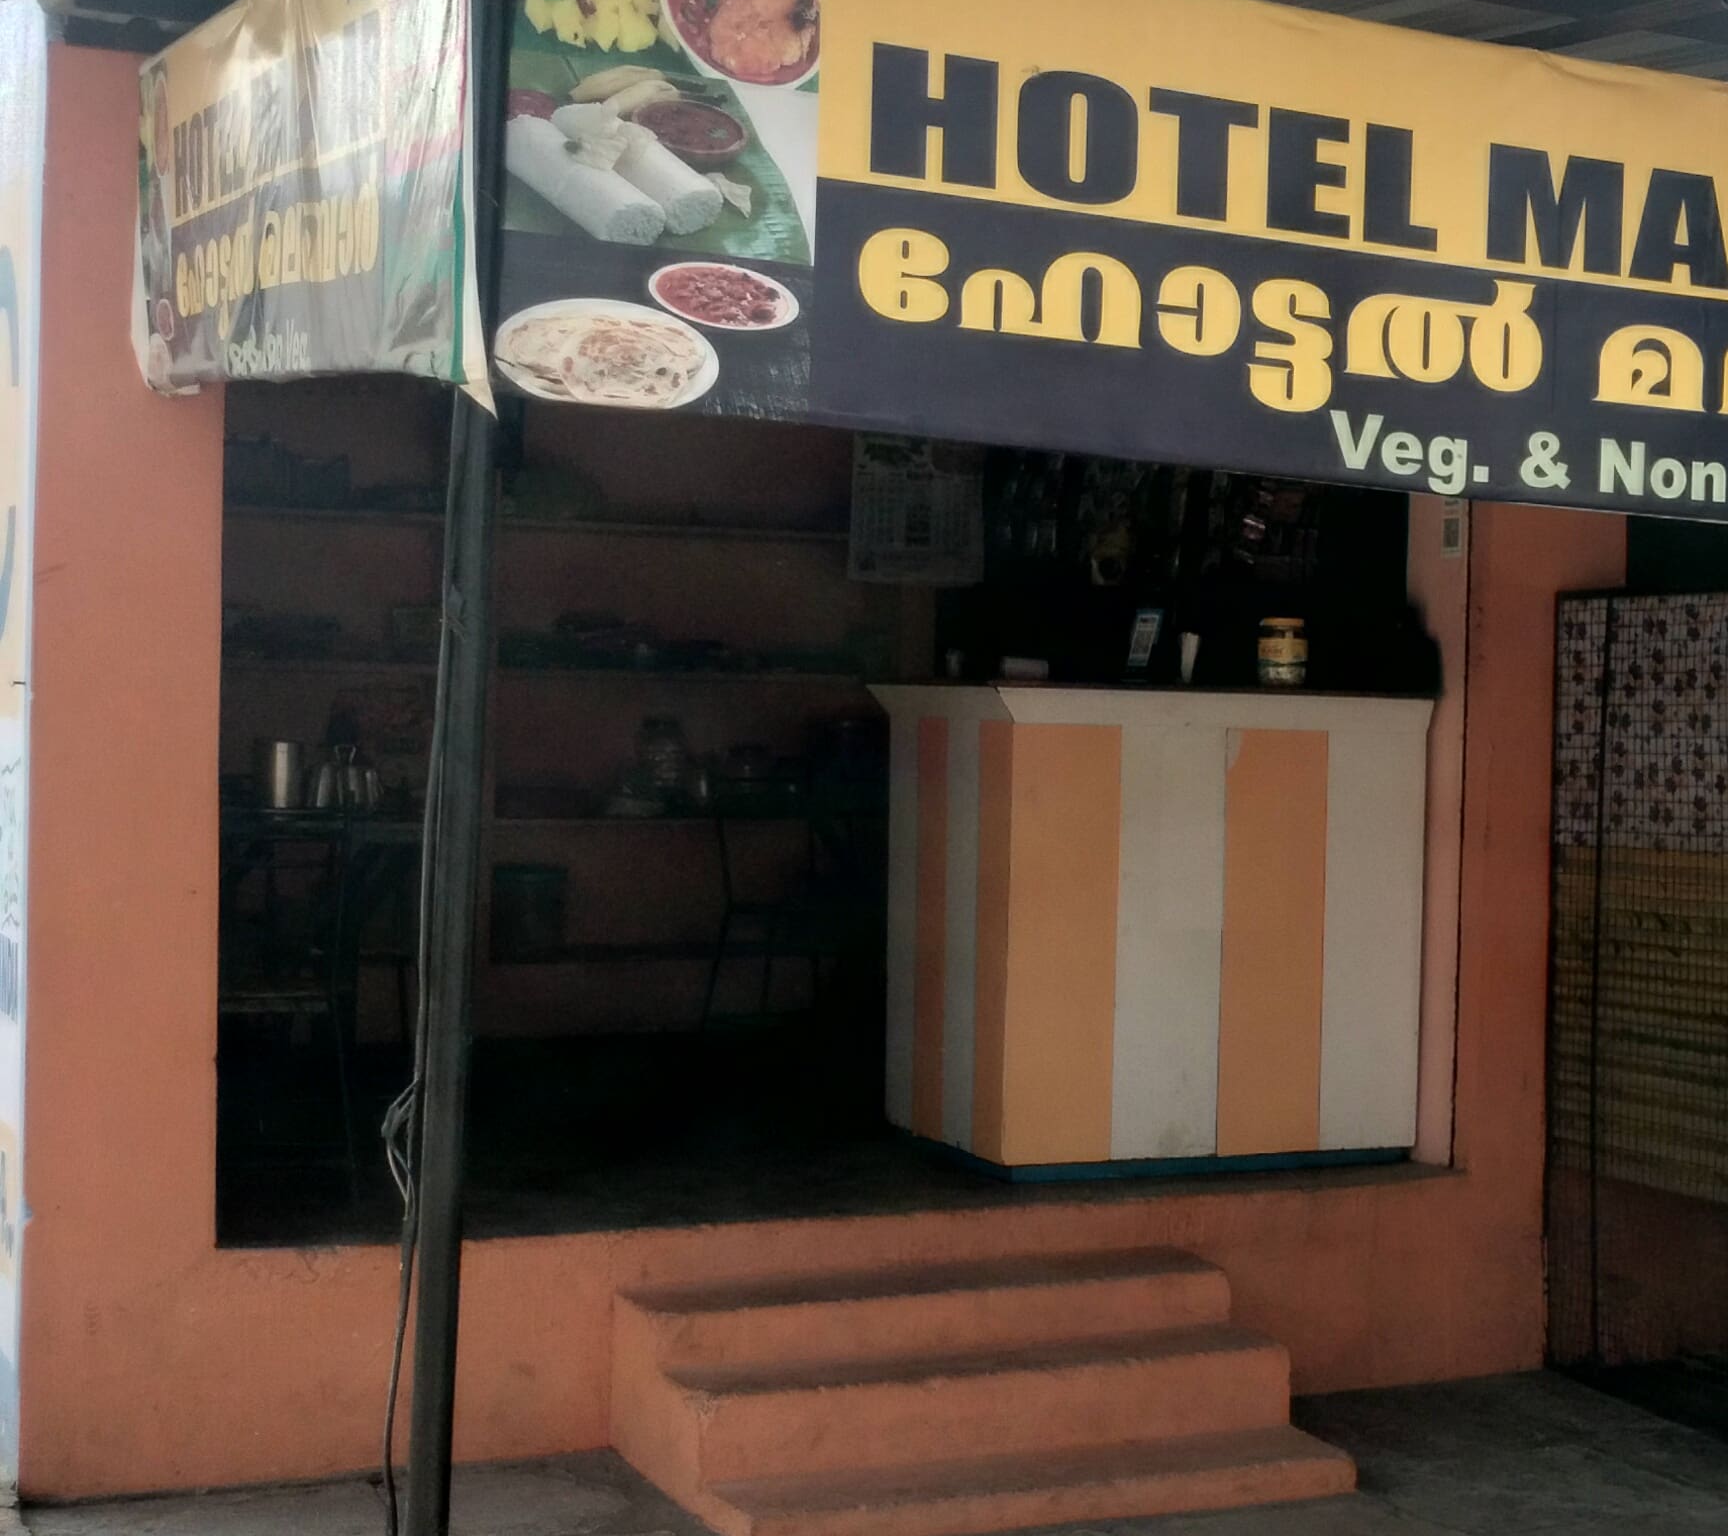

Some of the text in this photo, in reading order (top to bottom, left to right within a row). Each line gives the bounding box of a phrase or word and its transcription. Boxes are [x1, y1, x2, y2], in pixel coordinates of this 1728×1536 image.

[869, 41, 1439, 253] HOTEL
[857, 227, 1544, 413] ഹോട്ടൽ
[1329, 409, 1490, 496] Veg.
[1519, 430, 1572, 491] &
[1599, 438, 1728, 504] Non
